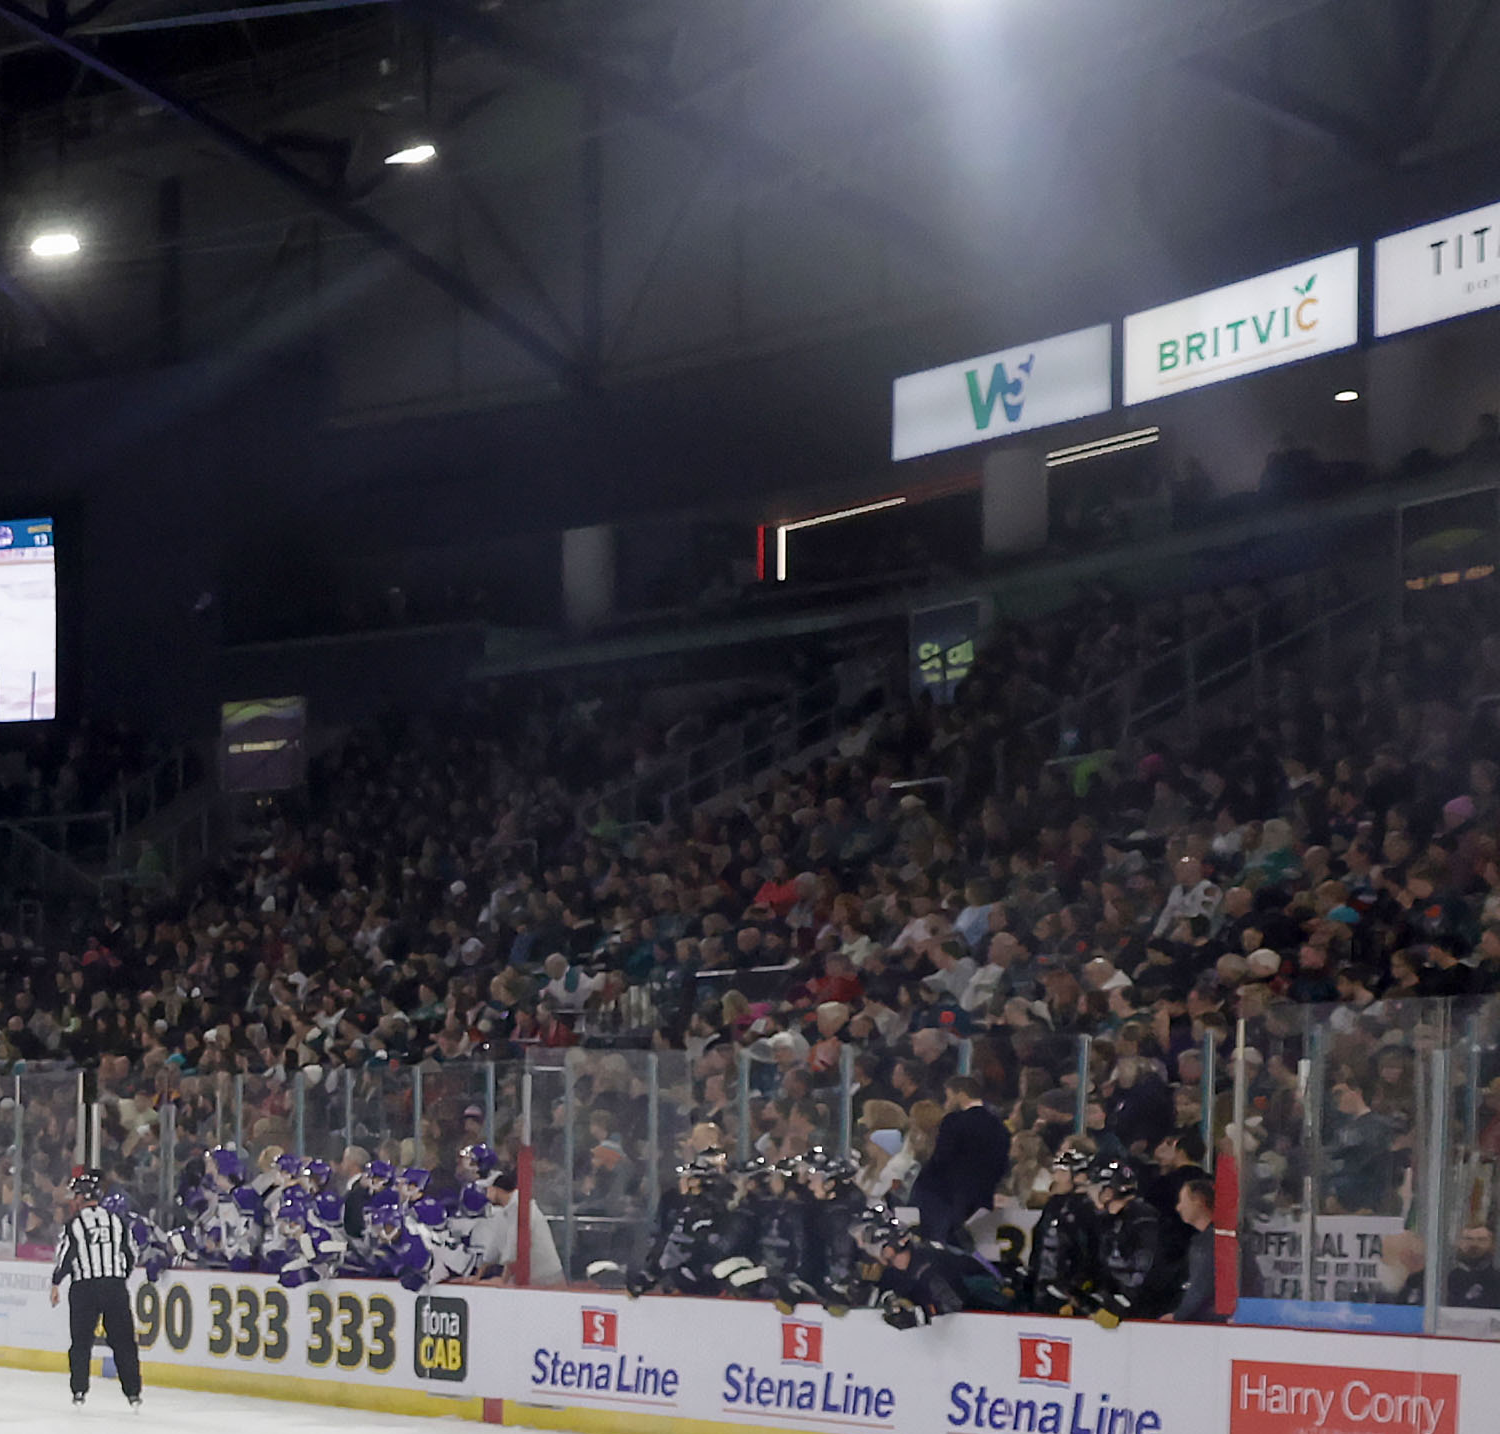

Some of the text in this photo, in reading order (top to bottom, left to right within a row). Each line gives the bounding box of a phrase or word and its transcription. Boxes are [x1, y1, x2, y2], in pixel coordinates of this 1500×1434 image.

[1427, 226, 1500, 276] TIT
[1158, 297, 1319, 374] BRITVIC
[135, 1281, 397, 1374] 90 333 333
[421, 1303, 461, 1337] fona
[419, 1337, 463, 1373] CAB
[1239, 1372, 1335, 1426] Harry
